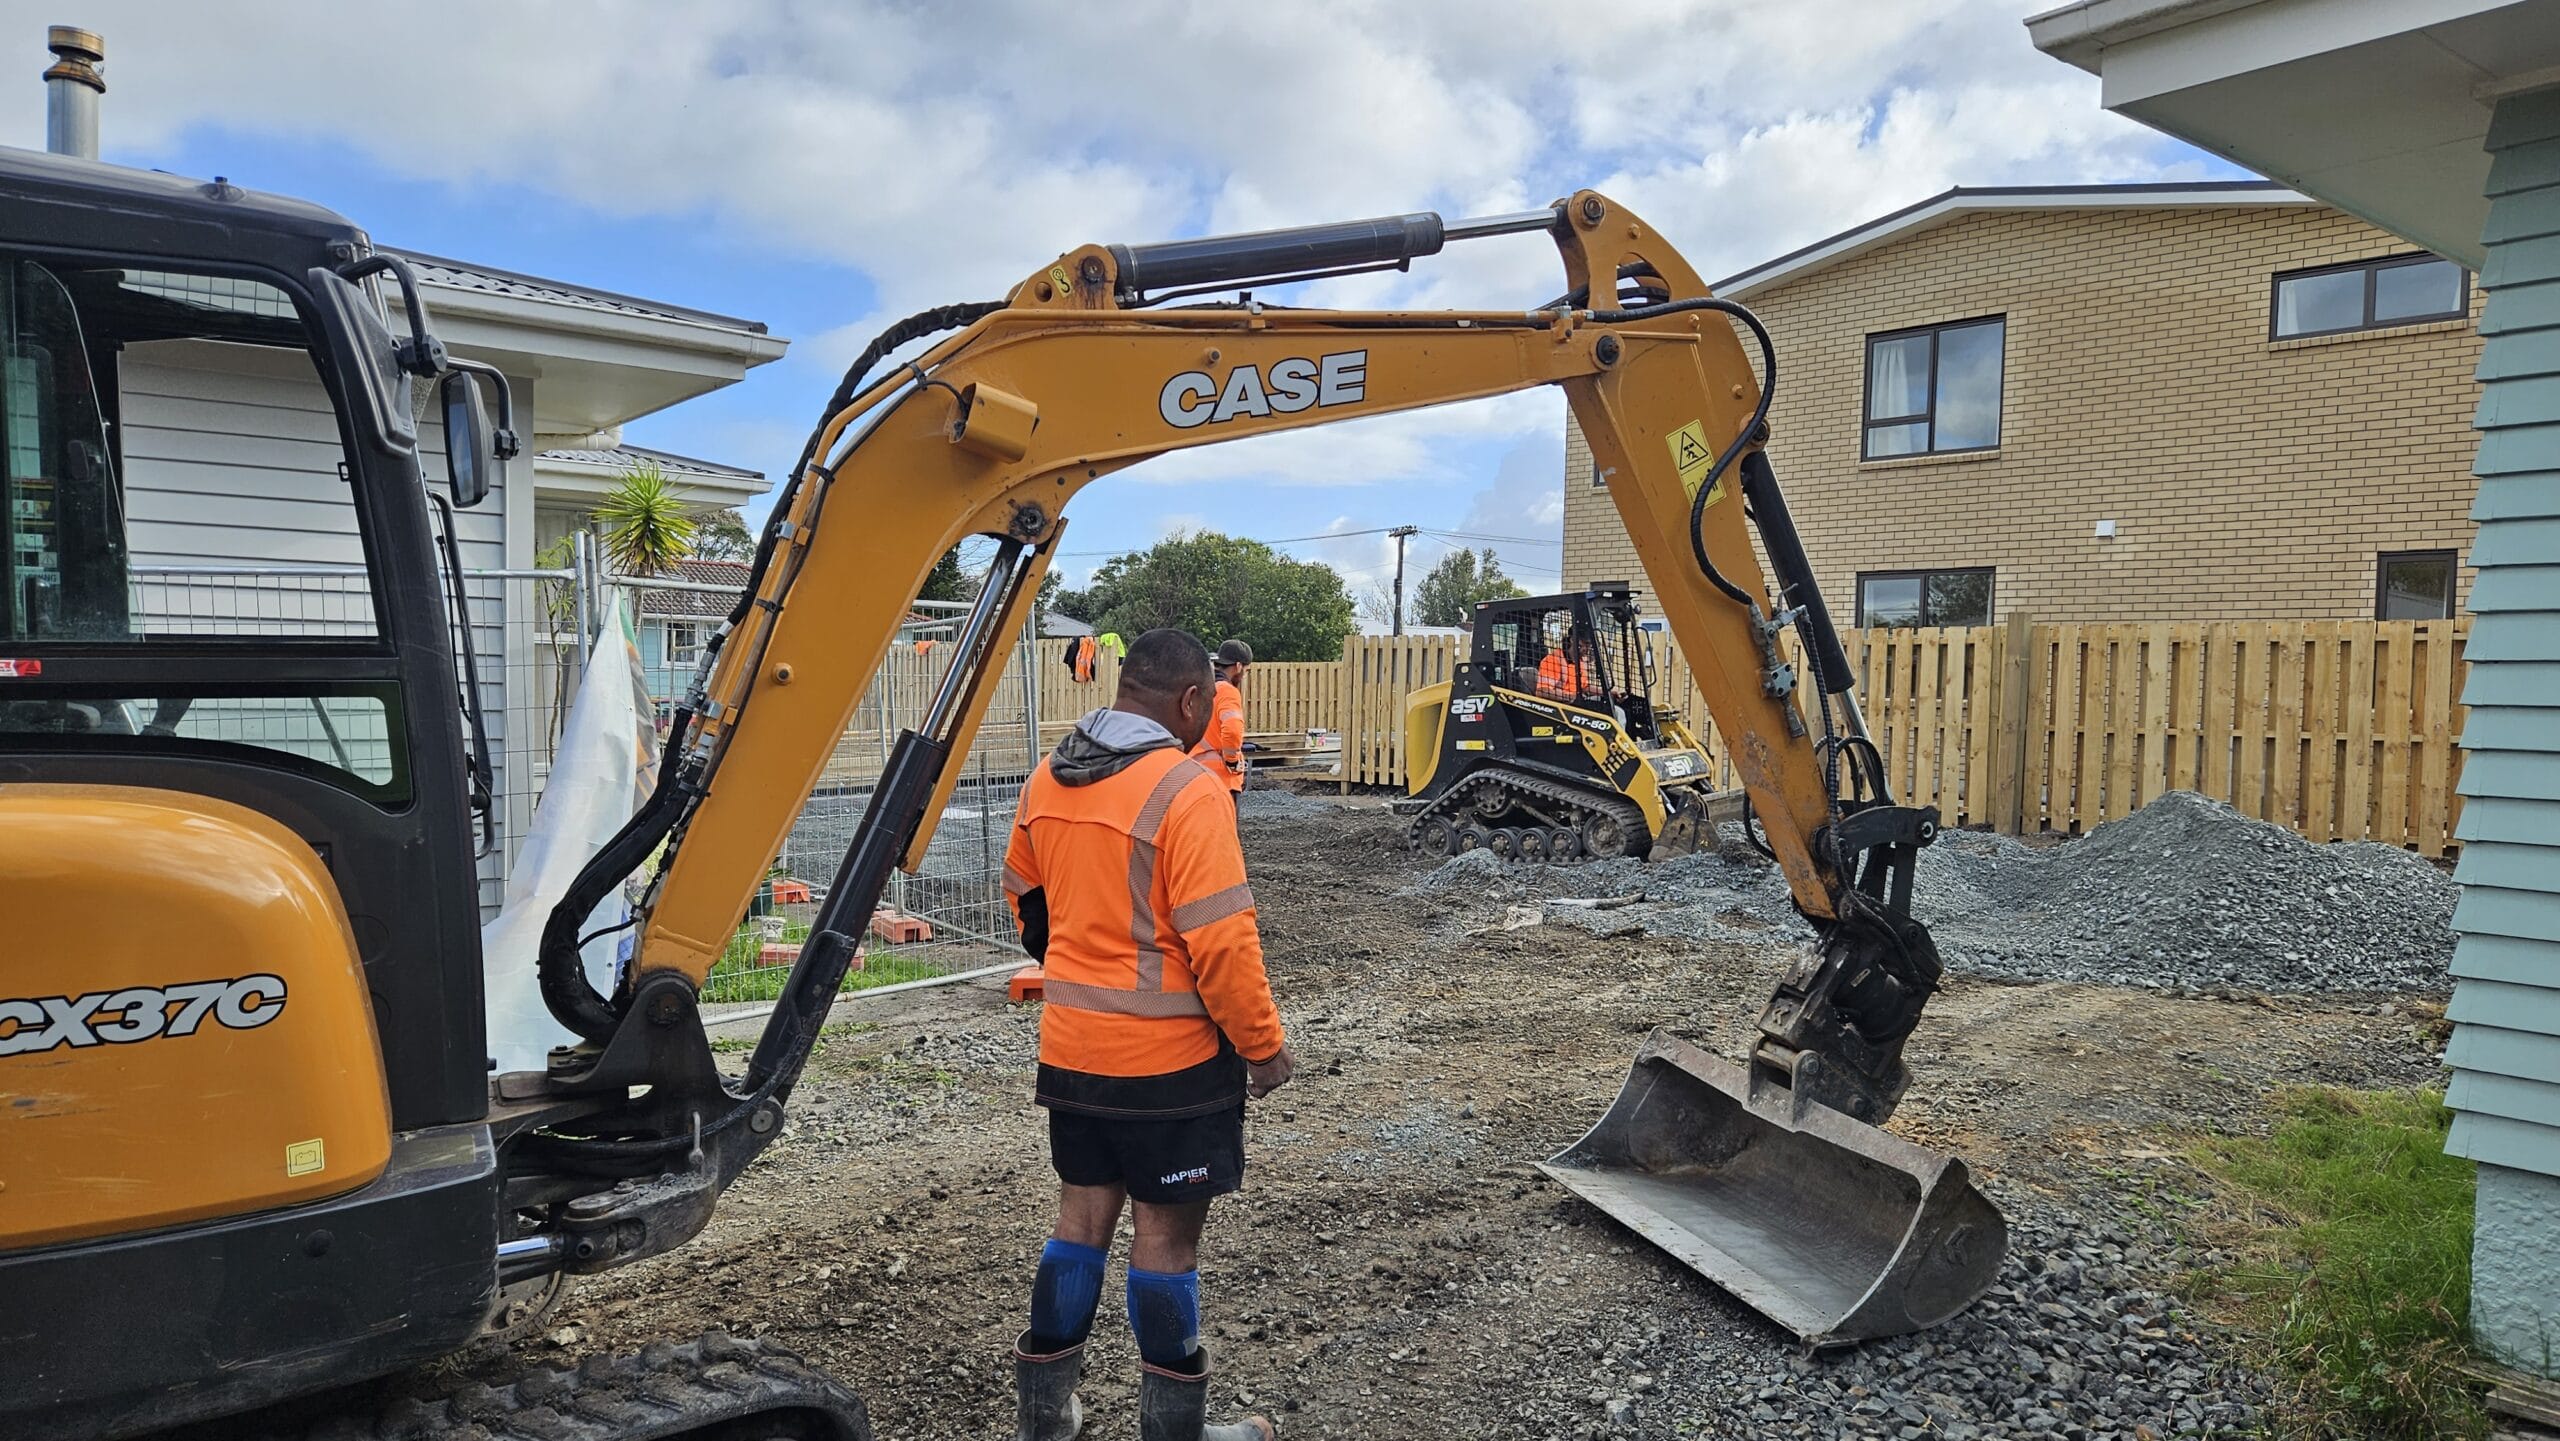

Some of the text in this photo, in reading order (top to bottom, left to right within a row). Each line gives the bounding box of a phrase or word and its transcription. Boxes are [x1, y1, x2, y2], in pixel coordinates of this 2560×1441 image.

[1159, 349, 1367, 429] CASE
[0, 973, 287, 1057] CX37C
[1160, 1167, 1208, 1184] NAPIER
